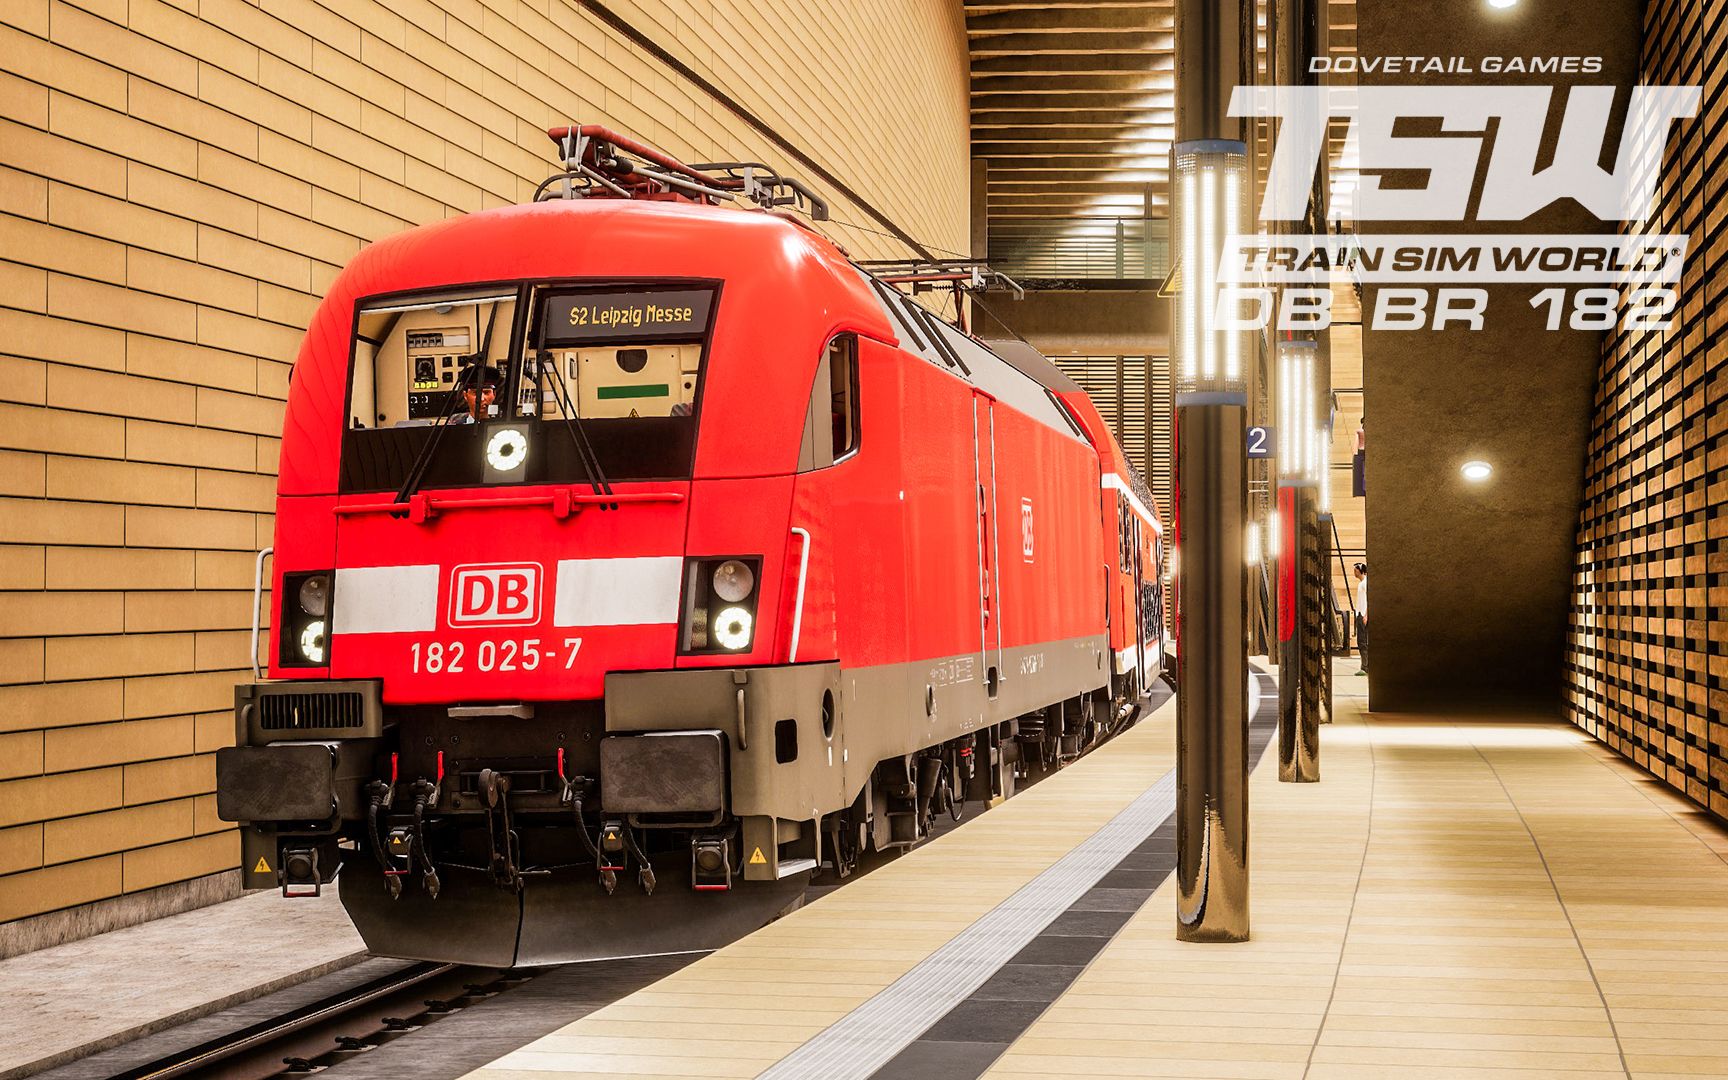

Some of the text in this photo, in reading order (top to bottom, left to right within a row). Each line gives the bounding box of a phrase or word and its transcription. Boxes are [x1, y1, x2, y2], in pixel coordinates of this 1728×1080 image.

[570, 304, 692, 328] S2 Leipzig Messe
[1249, 427, 1267, 453] 2
[460, 573, 529, 616] DB
[411, 641, 464, 674] 182
